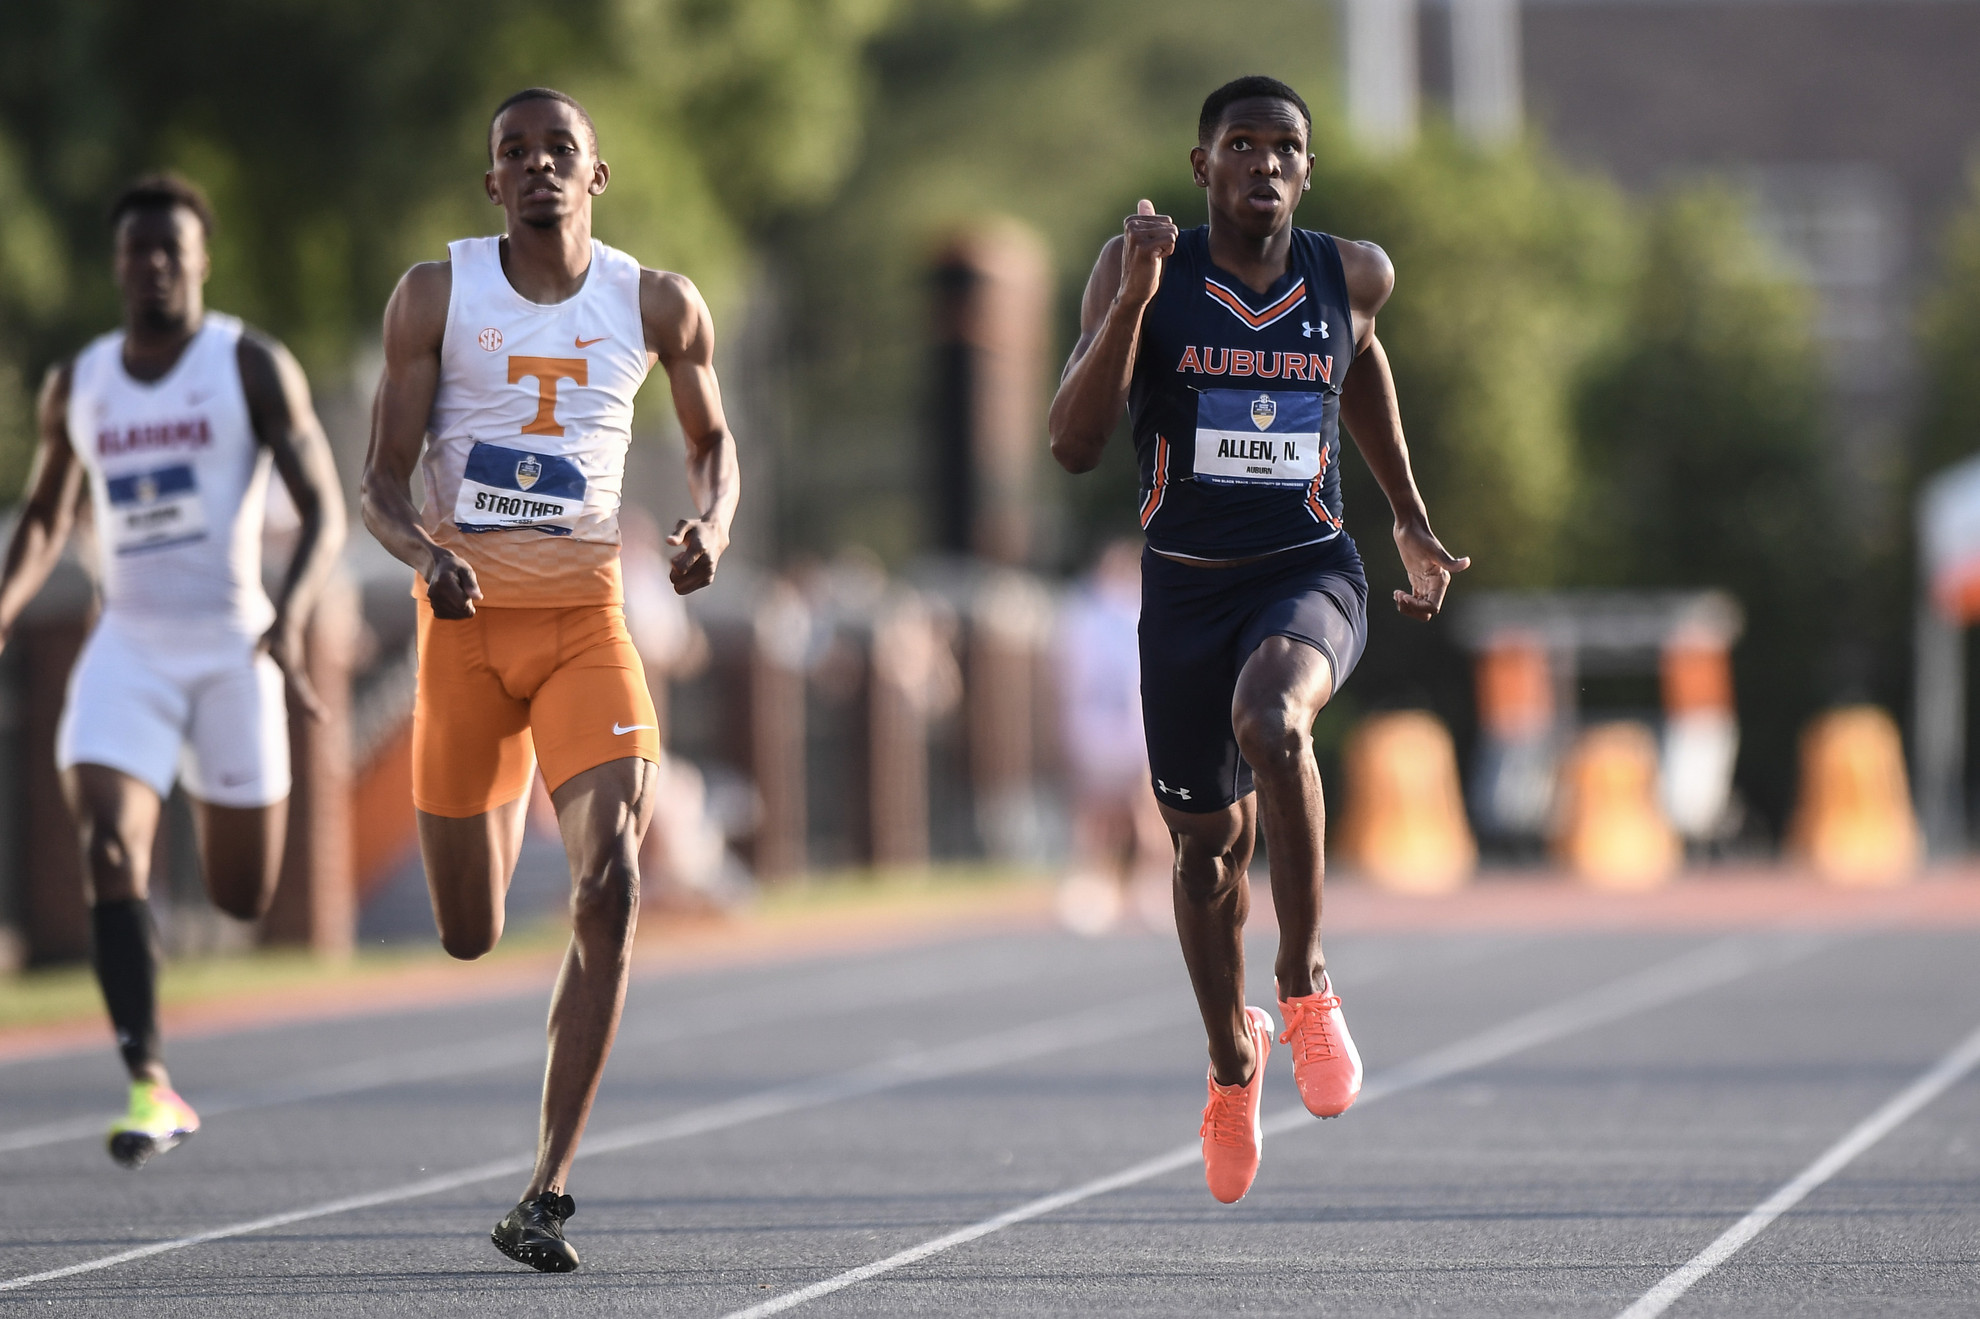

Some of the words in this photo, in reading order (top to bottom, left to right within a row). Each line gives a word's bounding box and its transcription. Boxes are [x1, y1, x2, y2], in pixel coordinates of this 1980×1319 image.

[479, 328, 503, 351] SEC
[1176, 345, 1334, 384] AUBURN
[507, 355, 588, 437] T
[1217, 438, 1278, 464] ALLEN,
[1283, 441, 1300, 461] N.
[1246, 466, 1273, 475] AUBURN
